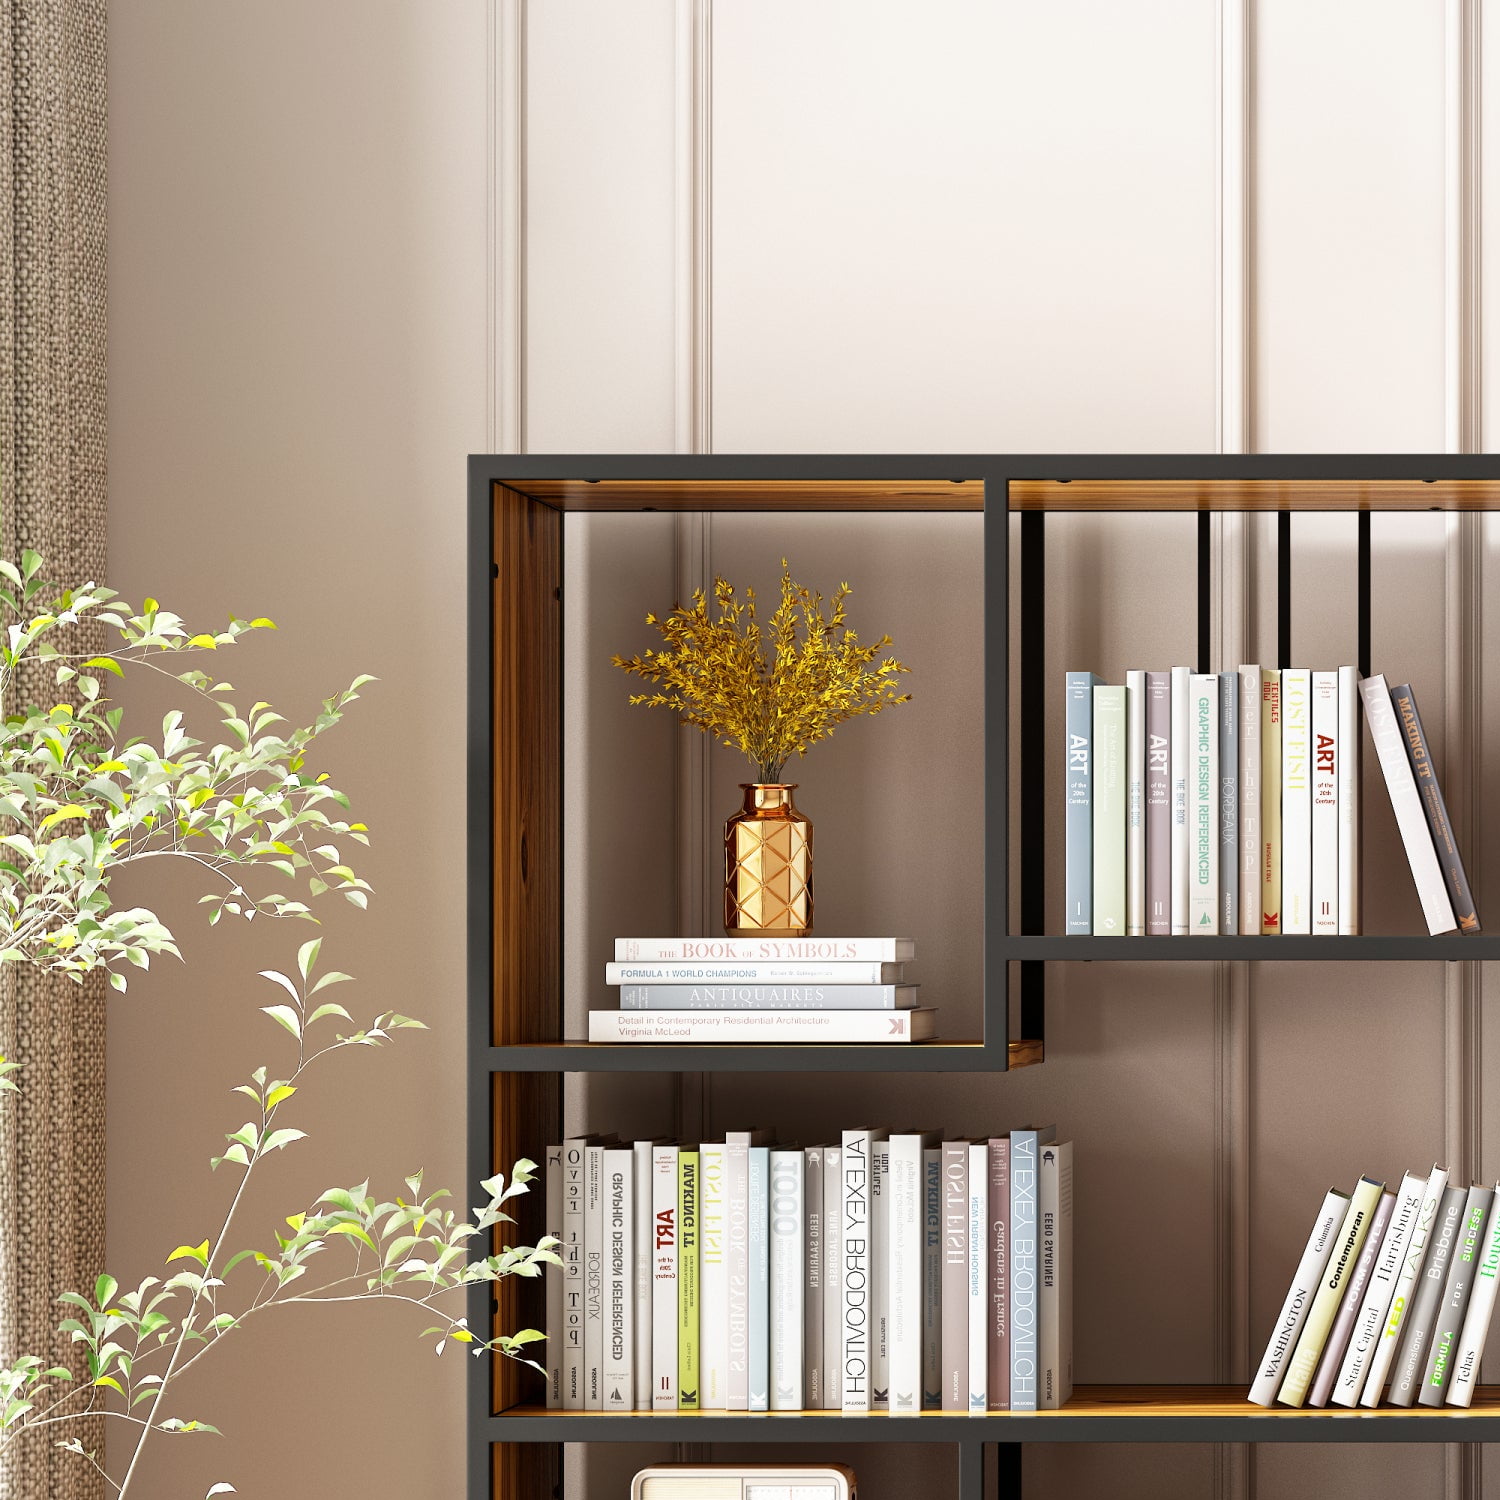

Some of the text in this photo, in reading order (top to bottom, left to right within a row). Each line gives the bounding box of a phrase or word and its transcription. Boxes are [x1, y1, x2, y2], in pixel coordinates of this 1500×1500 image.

[1288, 677, 1304, 789] LOST FISH
[1398, 696, 1432, 778] MAKING IT
[1070, 734, 1088, 775] ART
[1150, 734, 1167, 775] ART
[1316, 734, 1334, 775] ART
[1198, 697, 1210, 885] GRAPHIC DESIGN REFERENCED
[1315, 797, 1336, 806] Century
[1318, 782, 1334, 790] of the
[1222, 777, 1234, 845] BORDEAUX
[681, 943, 737, 958] BOOK
[759, 943, 856, 958] SYMBOLS
[620, 970, 757, 978] FORMULA 1 WORLD CHAMPIONS
[690, 987, 824, 1004] ANTIQUAIRES
[618, 1016, 829, 1028] Detail in Contemporary Residential Architecture
[618, 1028, 691, 1039] Virginia McLeod
[1328, 1210, 1364, 1290] Contemporan
[1347, 1216, 1385, 1312] FORM STYLE
[1264, 1216, 1334, 1379] WASHINGTON Columbia
[1344, 1196, 1420, 1390] State Capital Harrisburg
[1400, 1205, 1458, 1390] Queensland Brisbane
[1430, 1206, 1483, 1387] FORMULA FOR SUCCESS
[1385, 1297, 1405, 1339] TED
